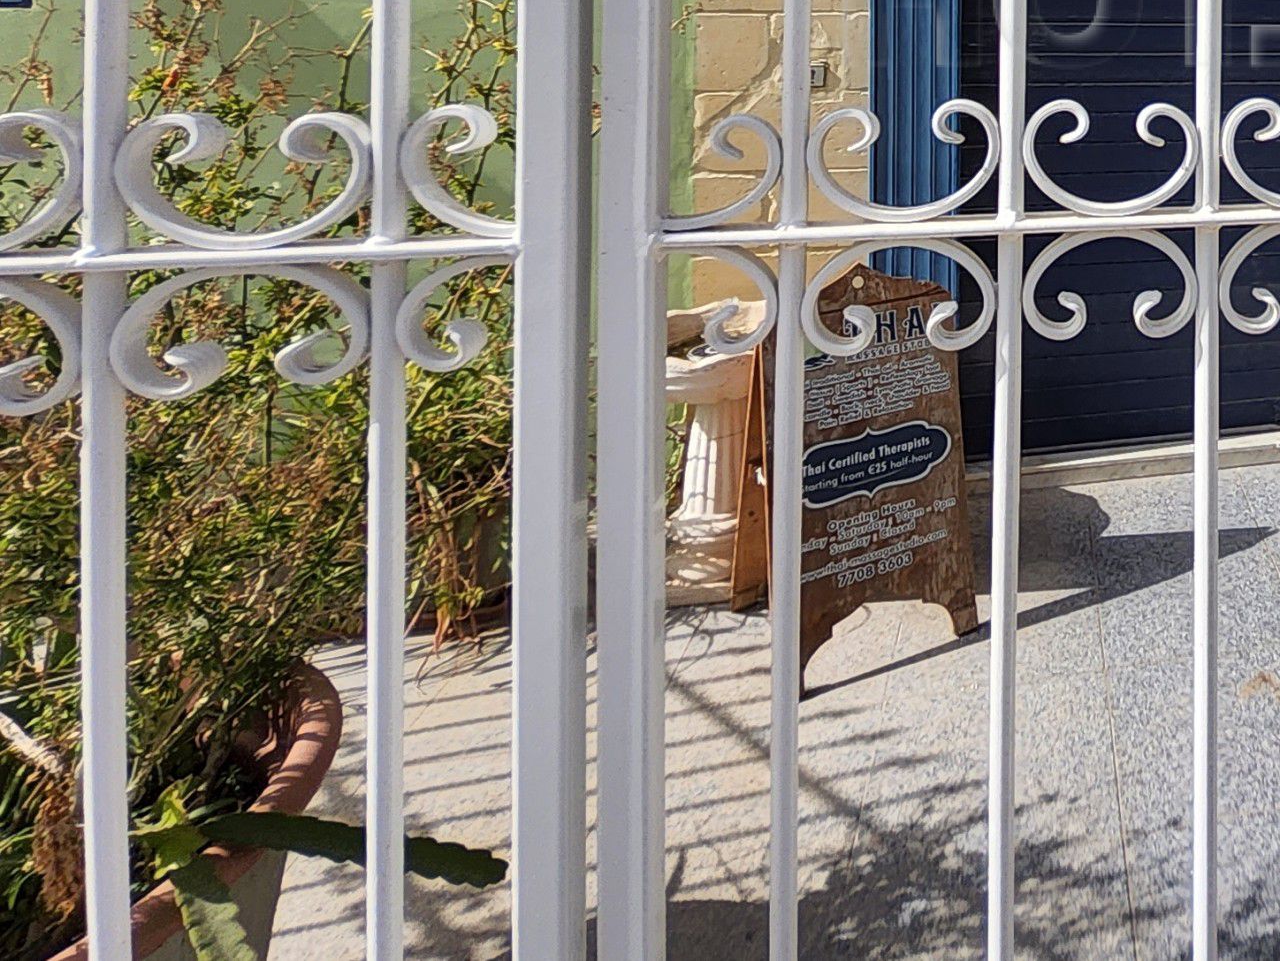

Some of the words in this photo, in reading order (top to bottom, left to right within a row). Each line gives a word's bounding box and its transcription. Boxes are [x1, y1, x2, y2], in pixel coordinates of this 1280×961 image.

[803, 461, 826, 477] Thai
[828, 448, 876, 470] Certified
[878, 436, 930, 457] Therapists
[841, 471, 865, 483] from
[868, 461, 888, 475] €25
[890, 451, 933, 469] half-hour
[827, 509, 880, 532] Opening
[881, 499, 916, 516] Hours
[837, 518, 887, 540] Saturday
[895, 508, 925, 523] 10am
[933, 497, 957, 512] 9pm
[829, 535, 871, 555] Sunday
[880, 518, 916, 539] Closed
[837, 564, 876, 588] 7708
[878, 551, 914, 574] 3603
